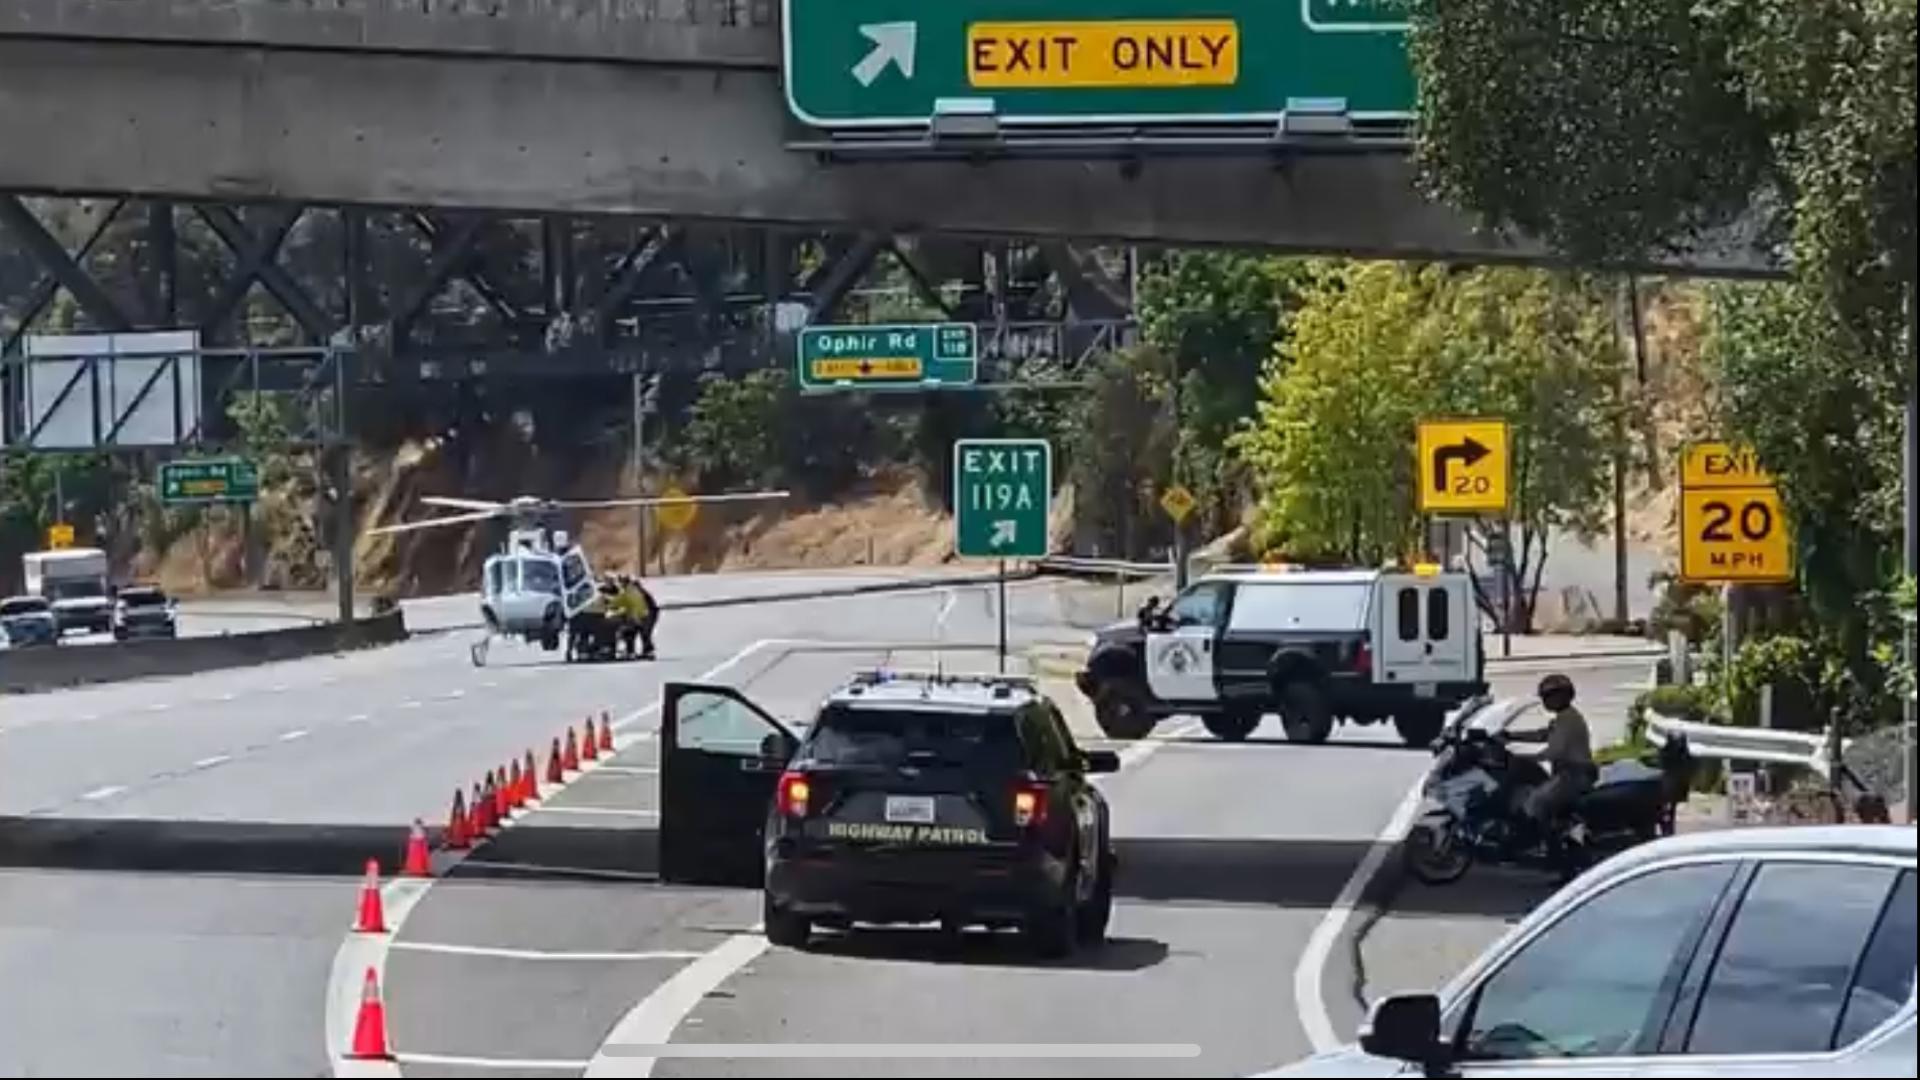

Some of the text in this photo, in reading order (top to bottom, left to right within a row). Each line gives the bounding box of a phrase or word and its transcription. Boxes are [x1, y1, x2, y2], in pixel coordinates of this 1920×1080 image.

[973, 35, 1230, 72] EXIT ONLY
[818, 333, 917, 353] Ophir Rd
[964, 449, 1040, 473] EXIT
[972, 483, 1032, 511] 119A
[1454, 476, 1490, 495] 20
[1700, 501, 1772, 542] 20
[1710, 552, 1764, 569] MPH
[829, 822, 988, 845] HIGHWAY PATROL
